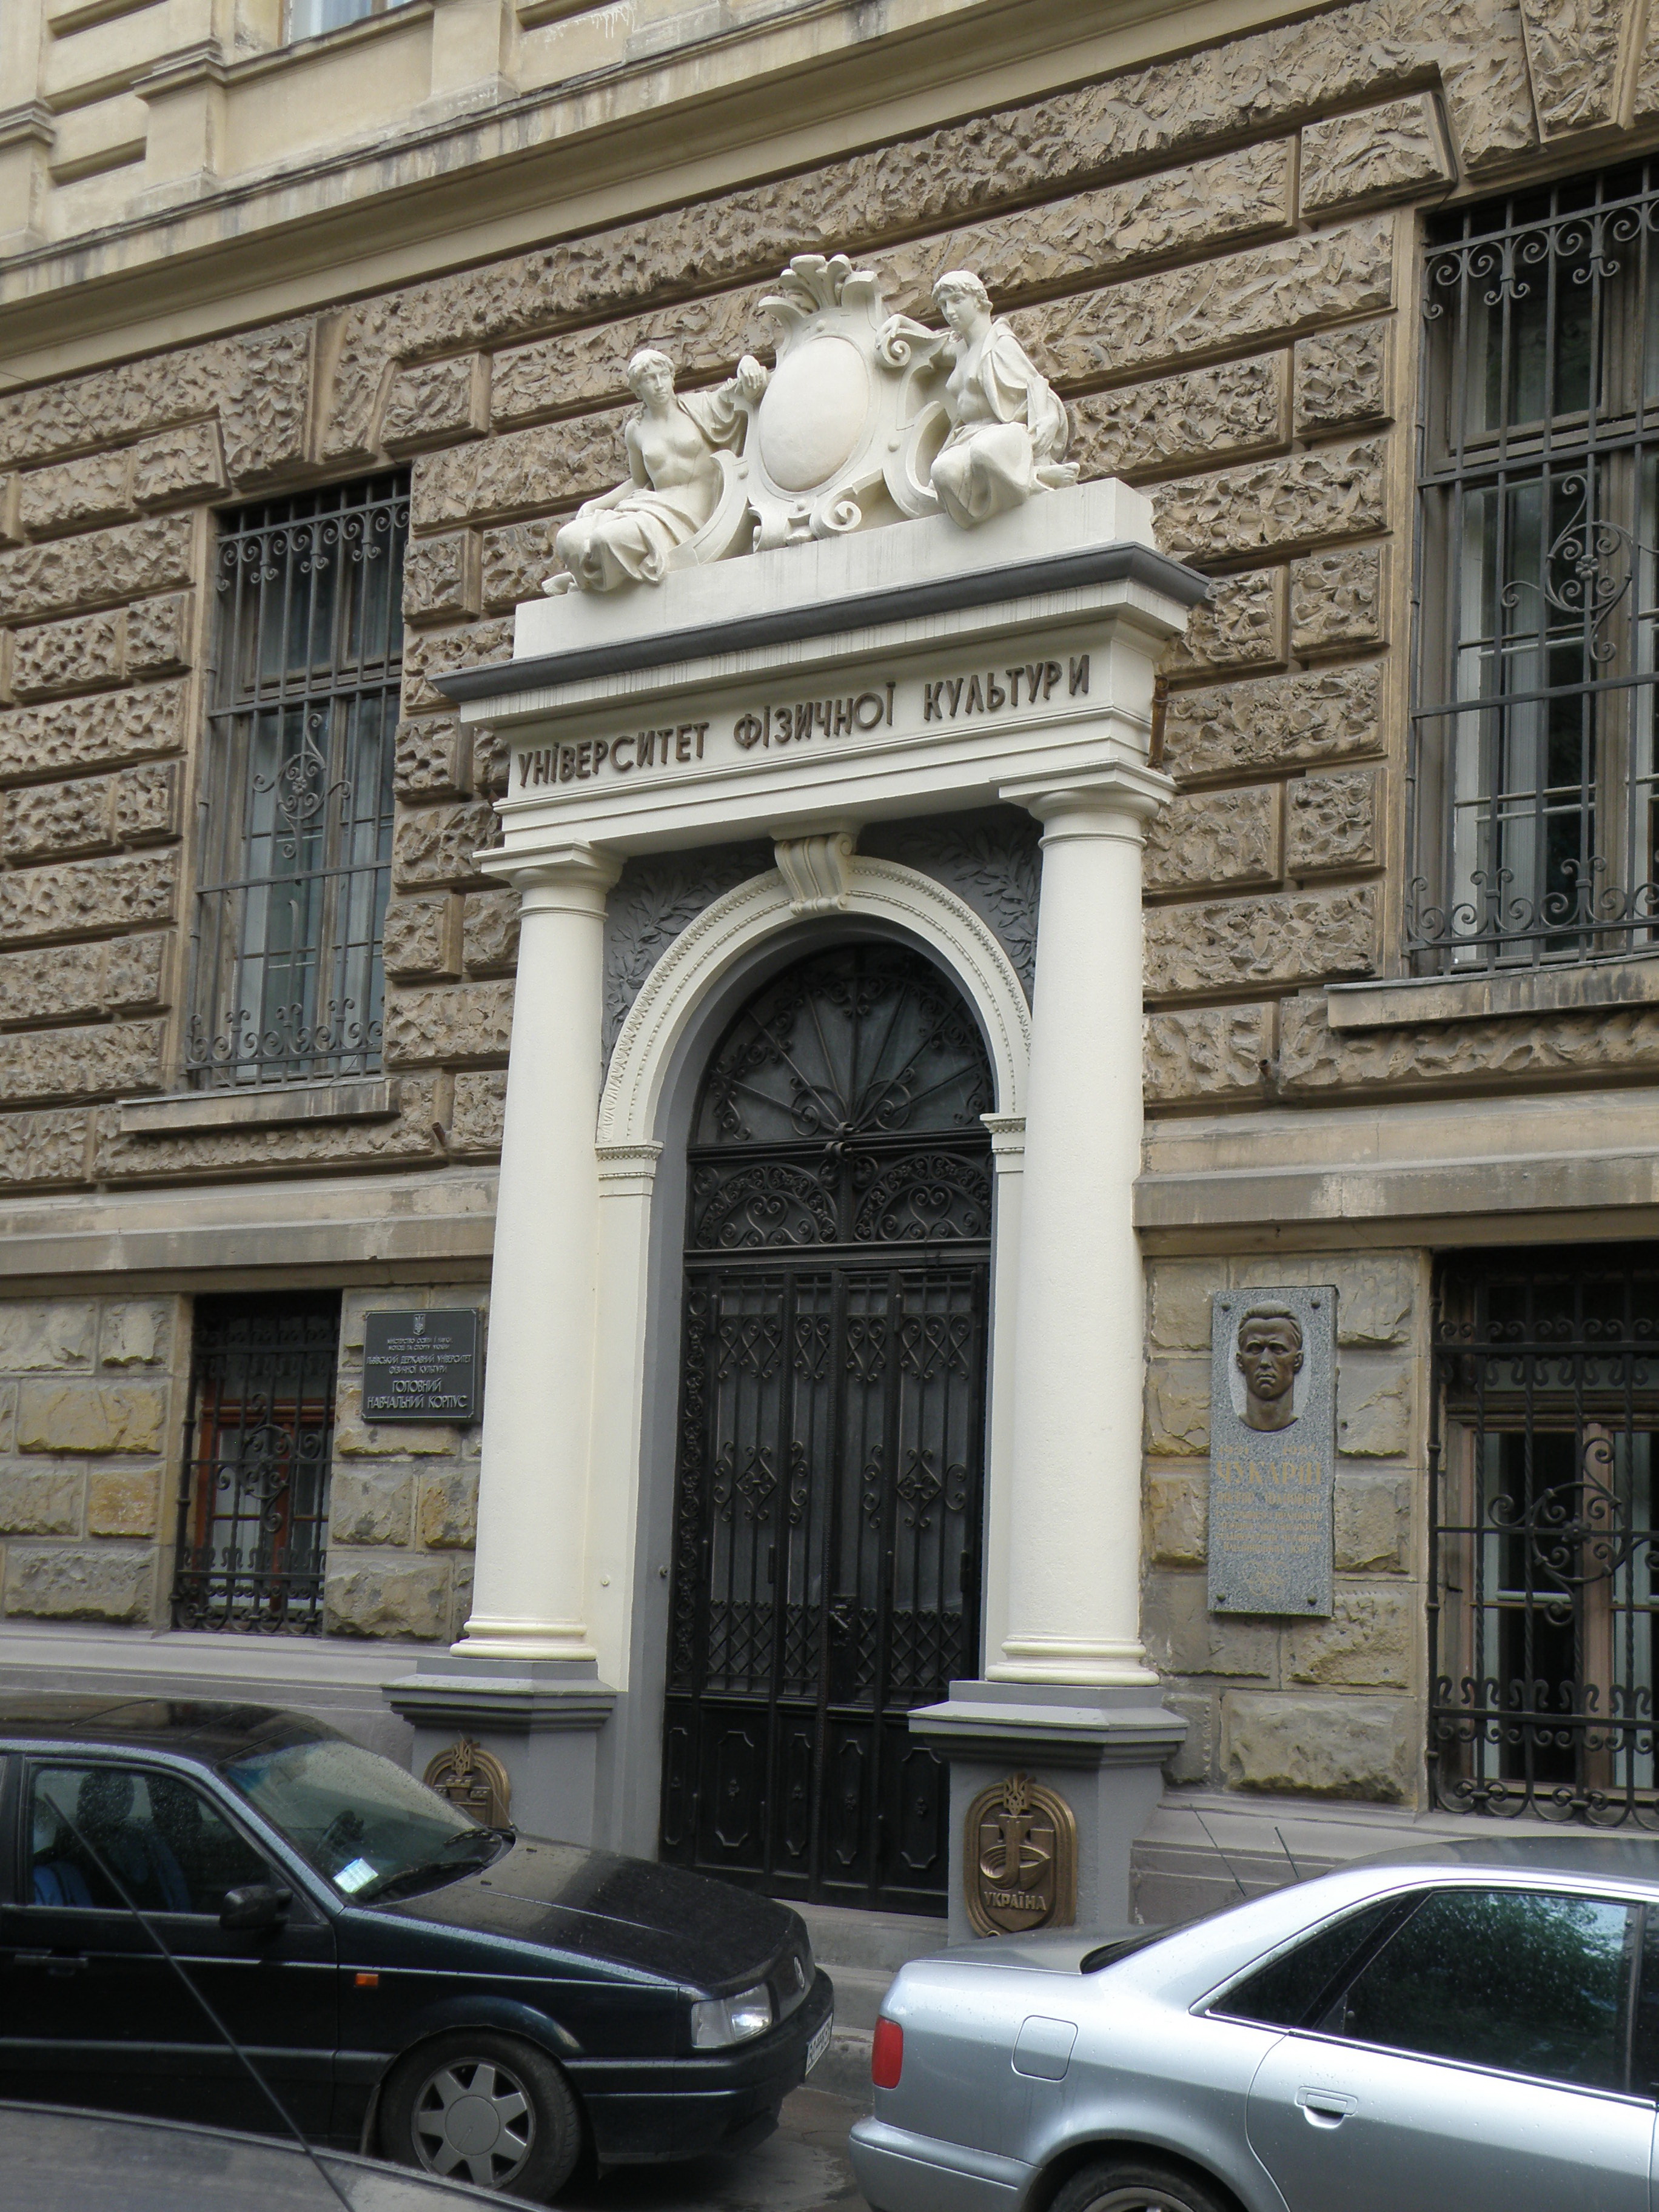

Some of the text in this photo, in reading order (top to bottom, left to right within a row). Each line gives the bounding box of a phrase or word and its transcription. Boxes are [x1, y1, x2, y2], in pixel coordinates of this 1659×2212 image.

[518, 654, 1090, 788] УНІВЕРСИТЕТ ФІЗИЧНОЇ КУЛЬТУРИ
[366, 1353, 472, 1365] ЛЬВІВСЬКИЙ ДЕРЖАВНИЙ УНІВЕРСИТЕТ
[389, 1365, 447, 1375] ФІЗИЧНОЇ КУЛЬТУРИ
[392, 1378, 441, 1393] ГОЛОВНИЙ
[367, 1394, 468, 1409] НАВЧАЛЬНИЙ КОРПУС
[984, 1891, 1047, 1911] УКРАЇНА
